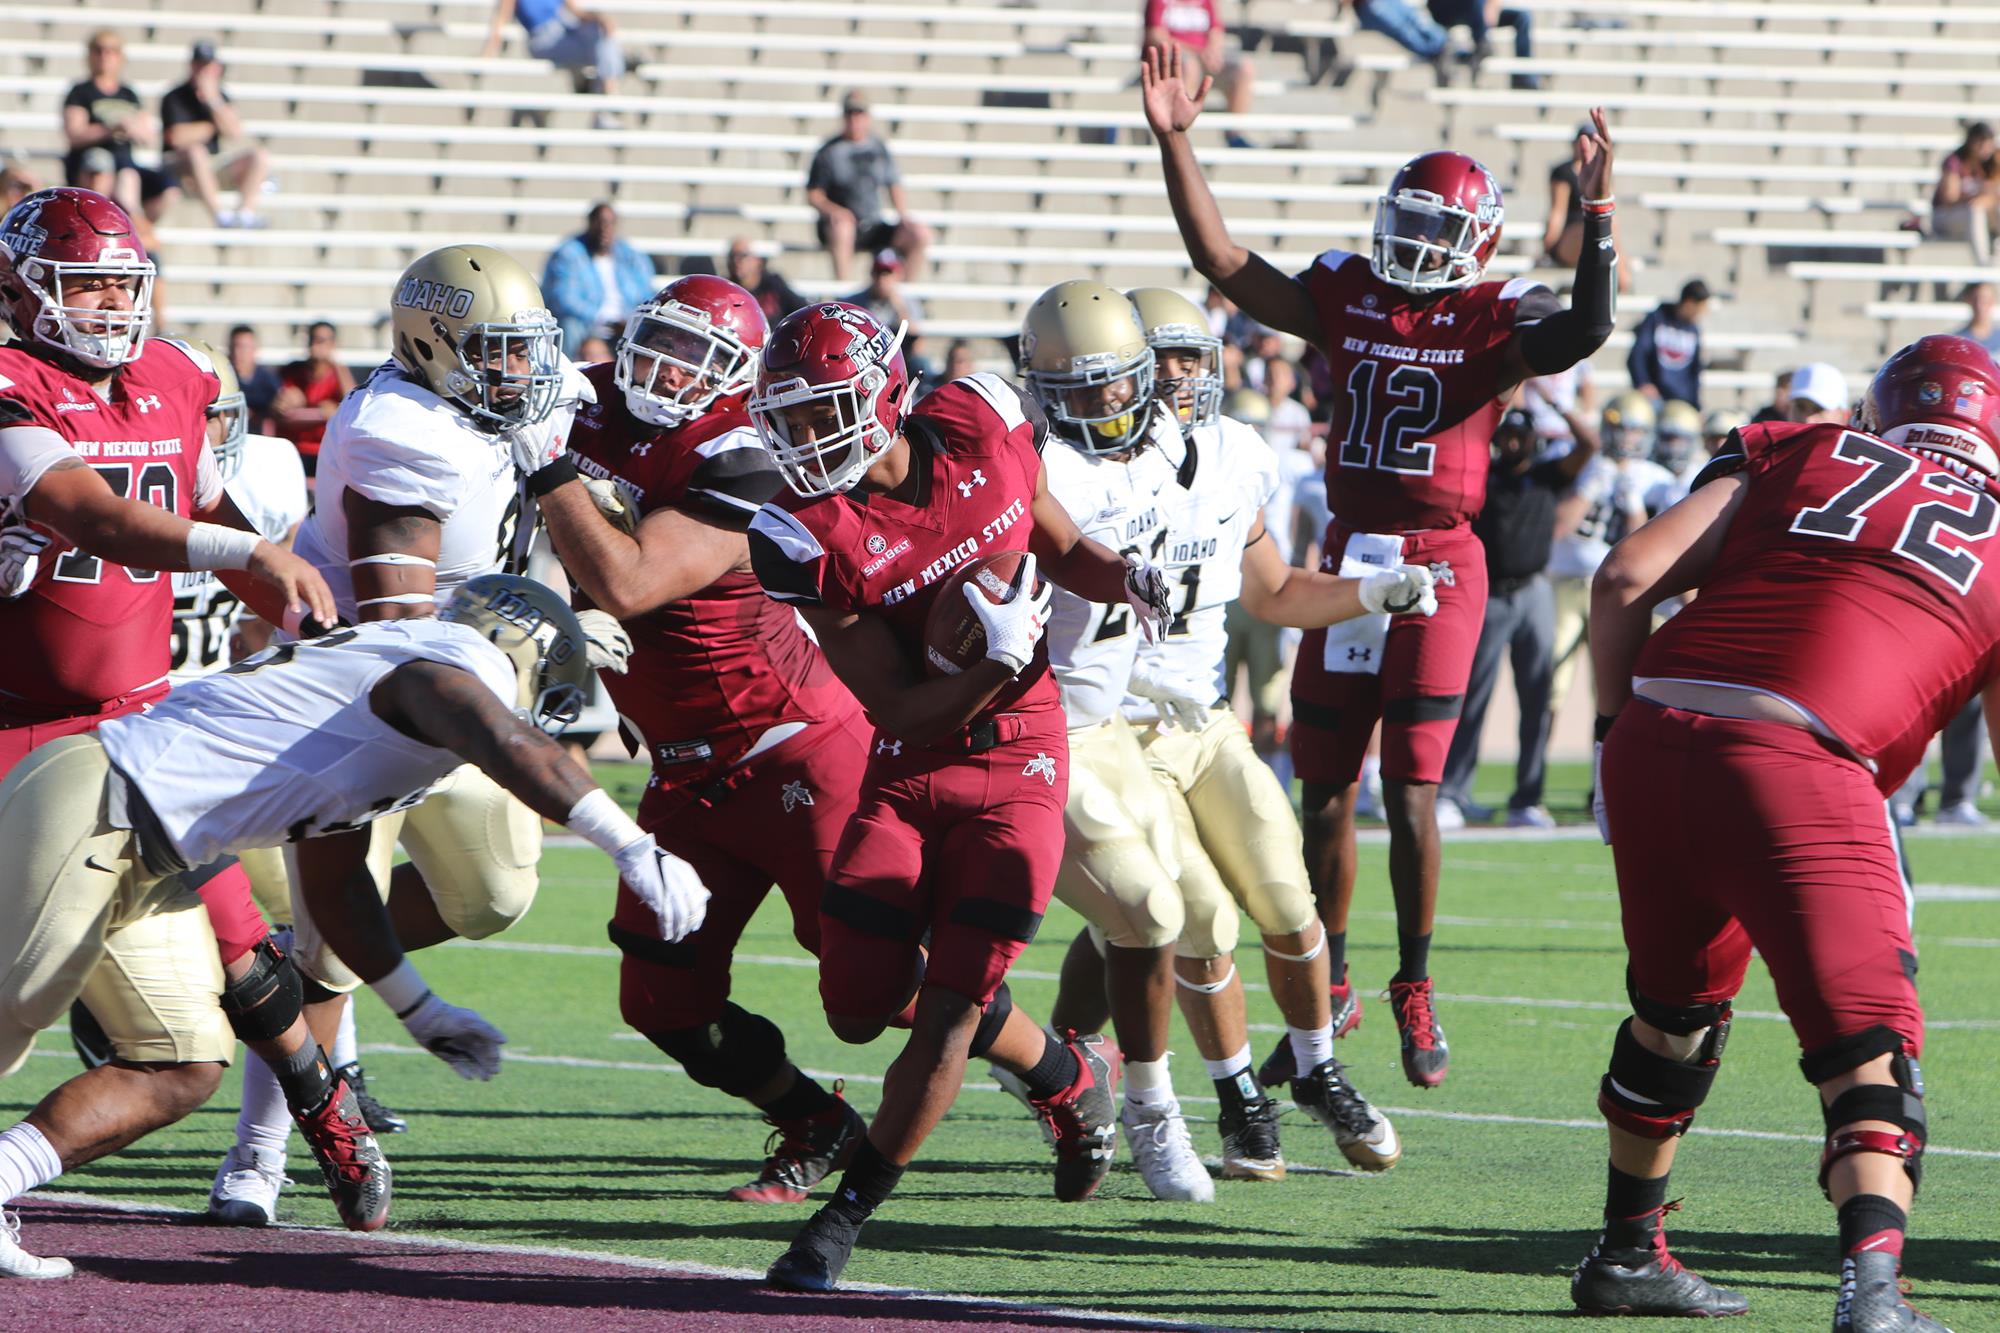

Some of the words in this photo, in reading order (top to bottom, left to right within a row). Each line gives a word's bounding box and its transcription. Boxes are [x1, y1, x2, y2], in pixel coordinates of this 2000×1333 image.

[0, 232, 40, 255] STATE
[396, 275, 475, 319] IDAHO
[1342, 336, 1369, 353] NEW
[1369, 343, 1419, 361] MEXICO
[1420, 349, 1465, 364] STATE
[1339, 360, 1443, 477] 12
[103, 441, 149, 457] MEXICO
[151, 437, 183, 456] STATE
[53, 462, 178, 585] 70
[1787, 430, 2000, 596] 72
[863, 557, 887, 577] SUN
[885, 540, 912, 561] BELT
[882, 578, 917, 607] NEW
[920, 536, 979, 587] MEXICO
[982, 498, 1026, 544] STATE
[1173, 537, 1217, 562] IDAHO
